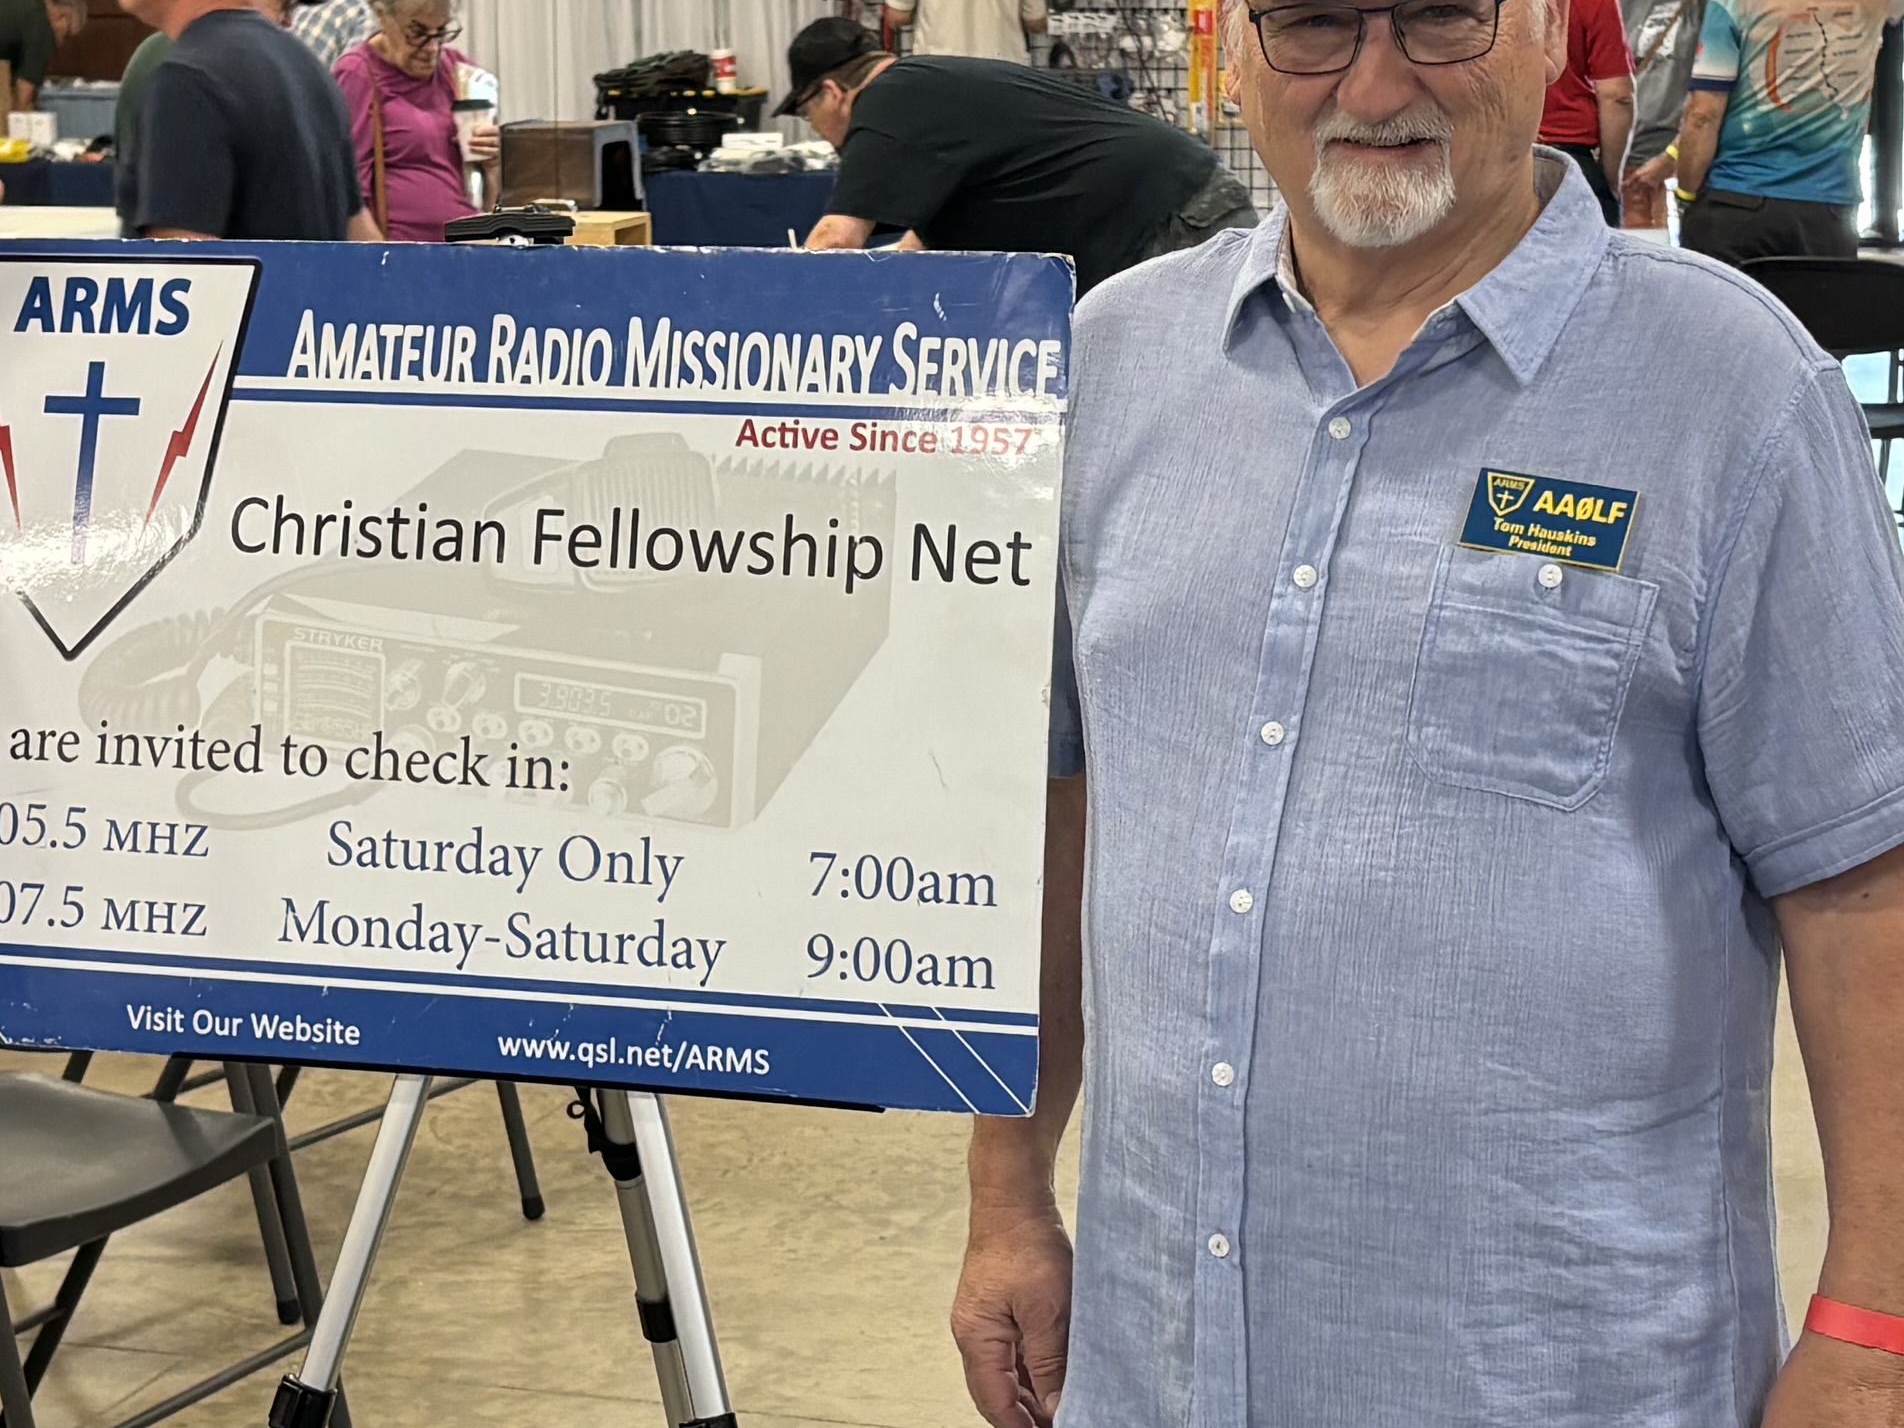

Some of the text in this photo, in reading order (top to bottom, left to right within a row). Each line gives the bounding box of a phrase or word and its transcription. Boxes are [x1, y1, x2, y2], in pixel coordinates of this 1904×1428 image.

[14, 276, 192, 335] ARMS
[287, 309, 1062, 399] AMATEUR RADIO MISSIONARY SERVICE
[735, 419, 1033, 457] Active Since 1957
[231, 494, 1033, 594] Christian Fellowship Net
[1494, 517, 1596, 547] Tom Hauskins
[1508, 535, 1572, 557] President
[293, 627, 383, 652] STRYKER
[9, 727, 81, 763] are
[96, 720, 264, 774] invited
[280, 735, 329, 777] to
[345, 731, 490, 788] check
[505, 742, 571, 792] in:
[102, 818, 210, 858] MHZ
[326, 819, 543, 894] Saturday
[559, 835, 685, 903] Only
[808, 851, 997, 908] 7:00am
[100, 897, 208, 937] MHZ
[278, 897, 728, 987] Monday-Saturday
[805, 932, 996, 990] 9:00am
[126, 1004, 771, 1075] Visit Our Website www.qsl.net/ARMS
